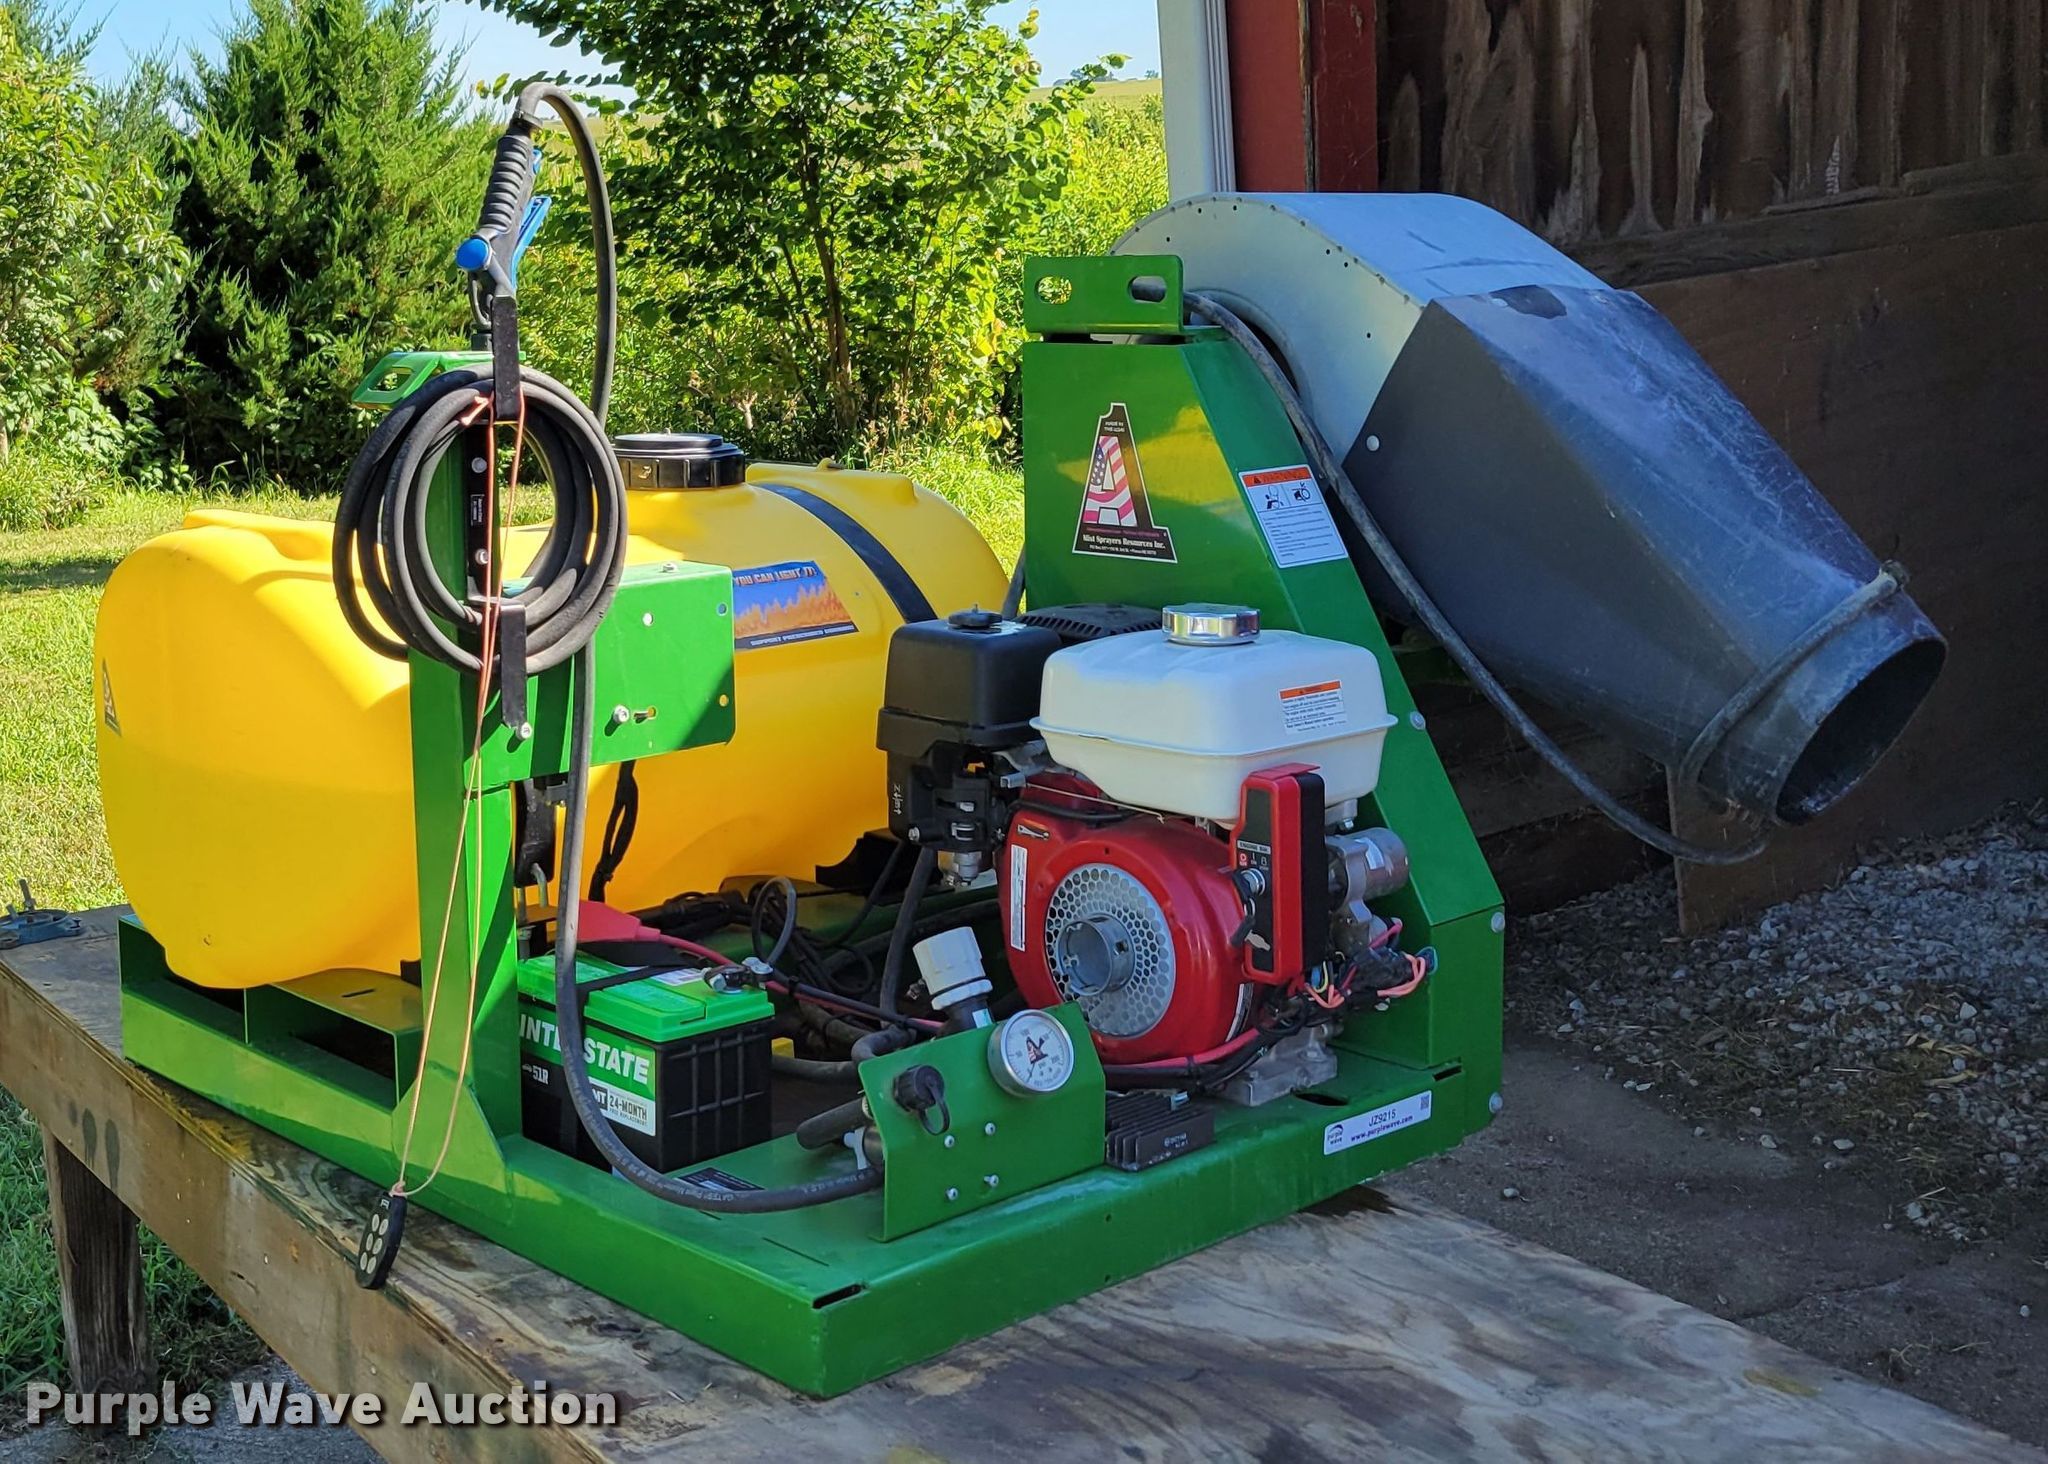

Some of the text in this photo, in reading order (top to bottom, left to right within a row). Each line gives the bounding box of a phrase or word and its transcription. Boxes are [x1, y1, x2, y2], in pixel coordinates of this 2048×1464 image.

[1083, 534, 1166, 549] Mist Sprayers Resources Inc.
[754, 572, 775, 583] CAN
[532, 1065, 549, 1085] 51R
[610, 1095, 647, 1121] 24-MONTH
[1368, 1108, 1397, 1127] JZ9215
[1351, 1115, 1413, 1142] www.purplewave.com
